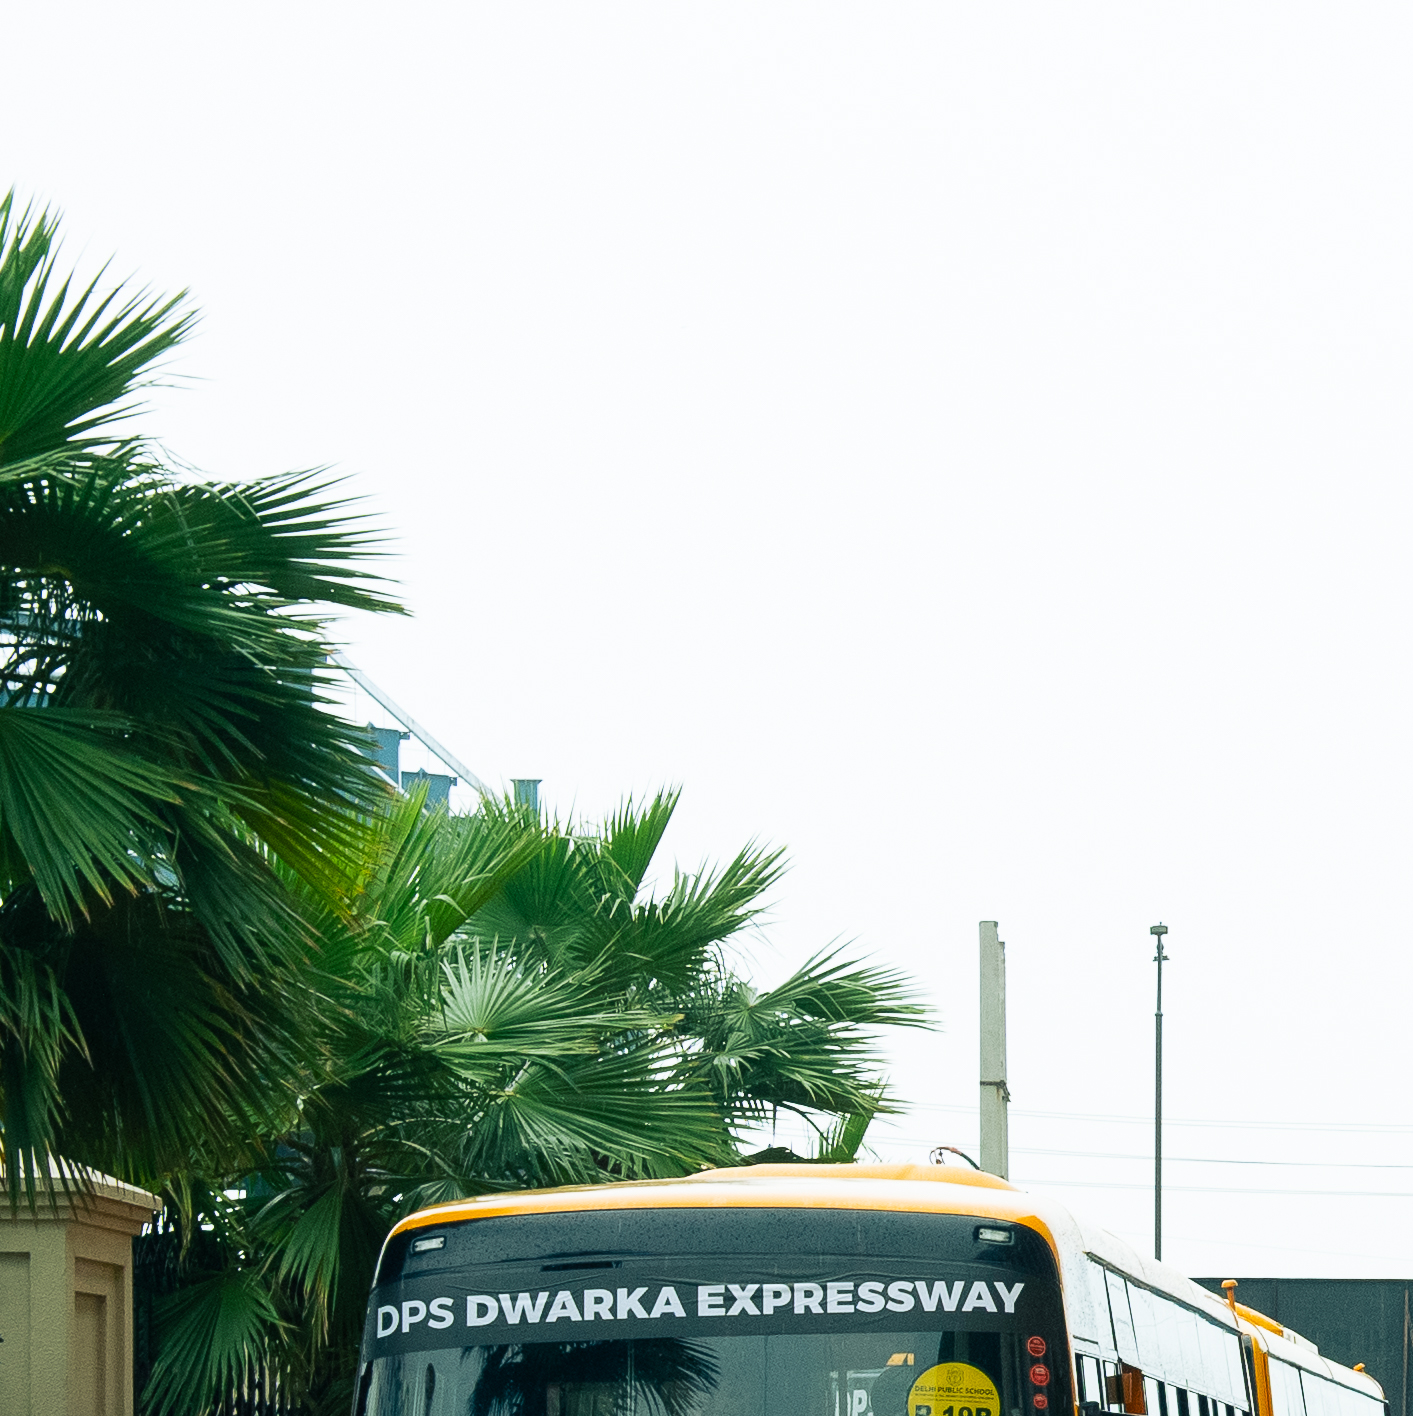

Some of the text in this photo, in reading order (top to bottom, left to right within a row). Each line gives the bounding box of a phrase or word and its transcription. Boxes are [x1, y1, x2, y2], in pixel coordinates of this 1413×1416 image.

[376, 1280, 1025, 1339] DPS DWARKA EXPRESSWAY
[914, 1385, 995, 1396] DELHI PUBLIC SCHOOL
